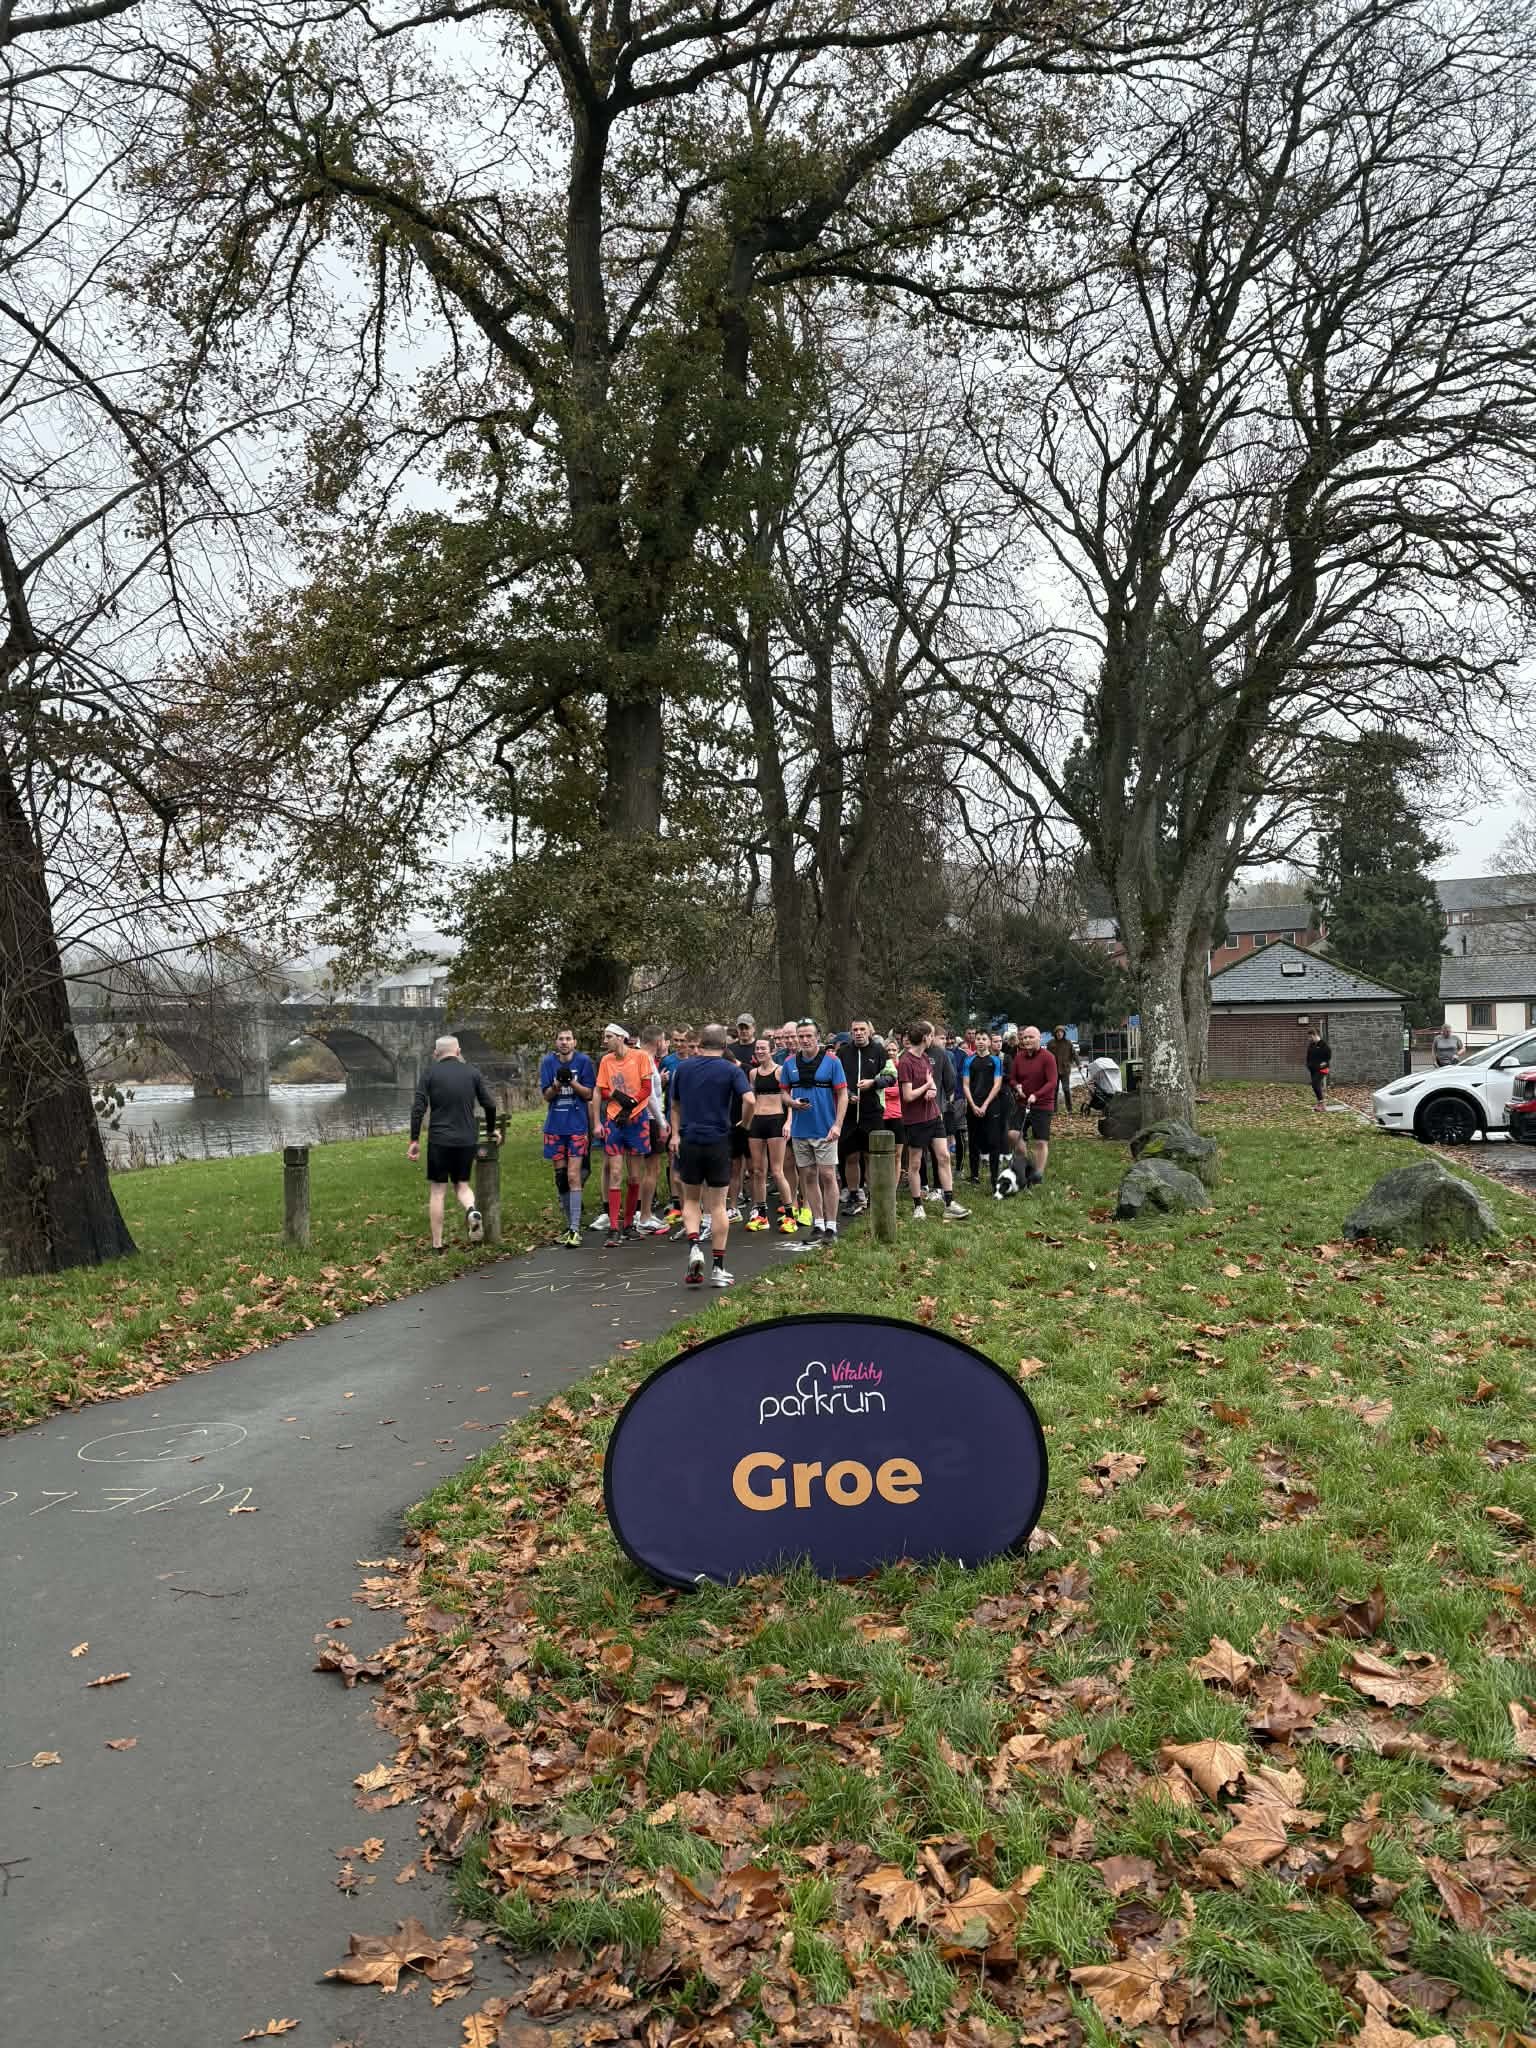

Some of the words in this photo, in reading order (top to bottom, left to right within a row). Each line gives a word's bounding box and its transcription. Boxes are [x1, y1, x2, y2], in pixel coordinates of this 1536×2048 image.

[482, 1280, 678, 1297] EVENT
[831, 1359, 883, 1386] Vitality
[759, 1379, 886, 1425] parkrun
[732, 1451, 923, 1511] Groe
